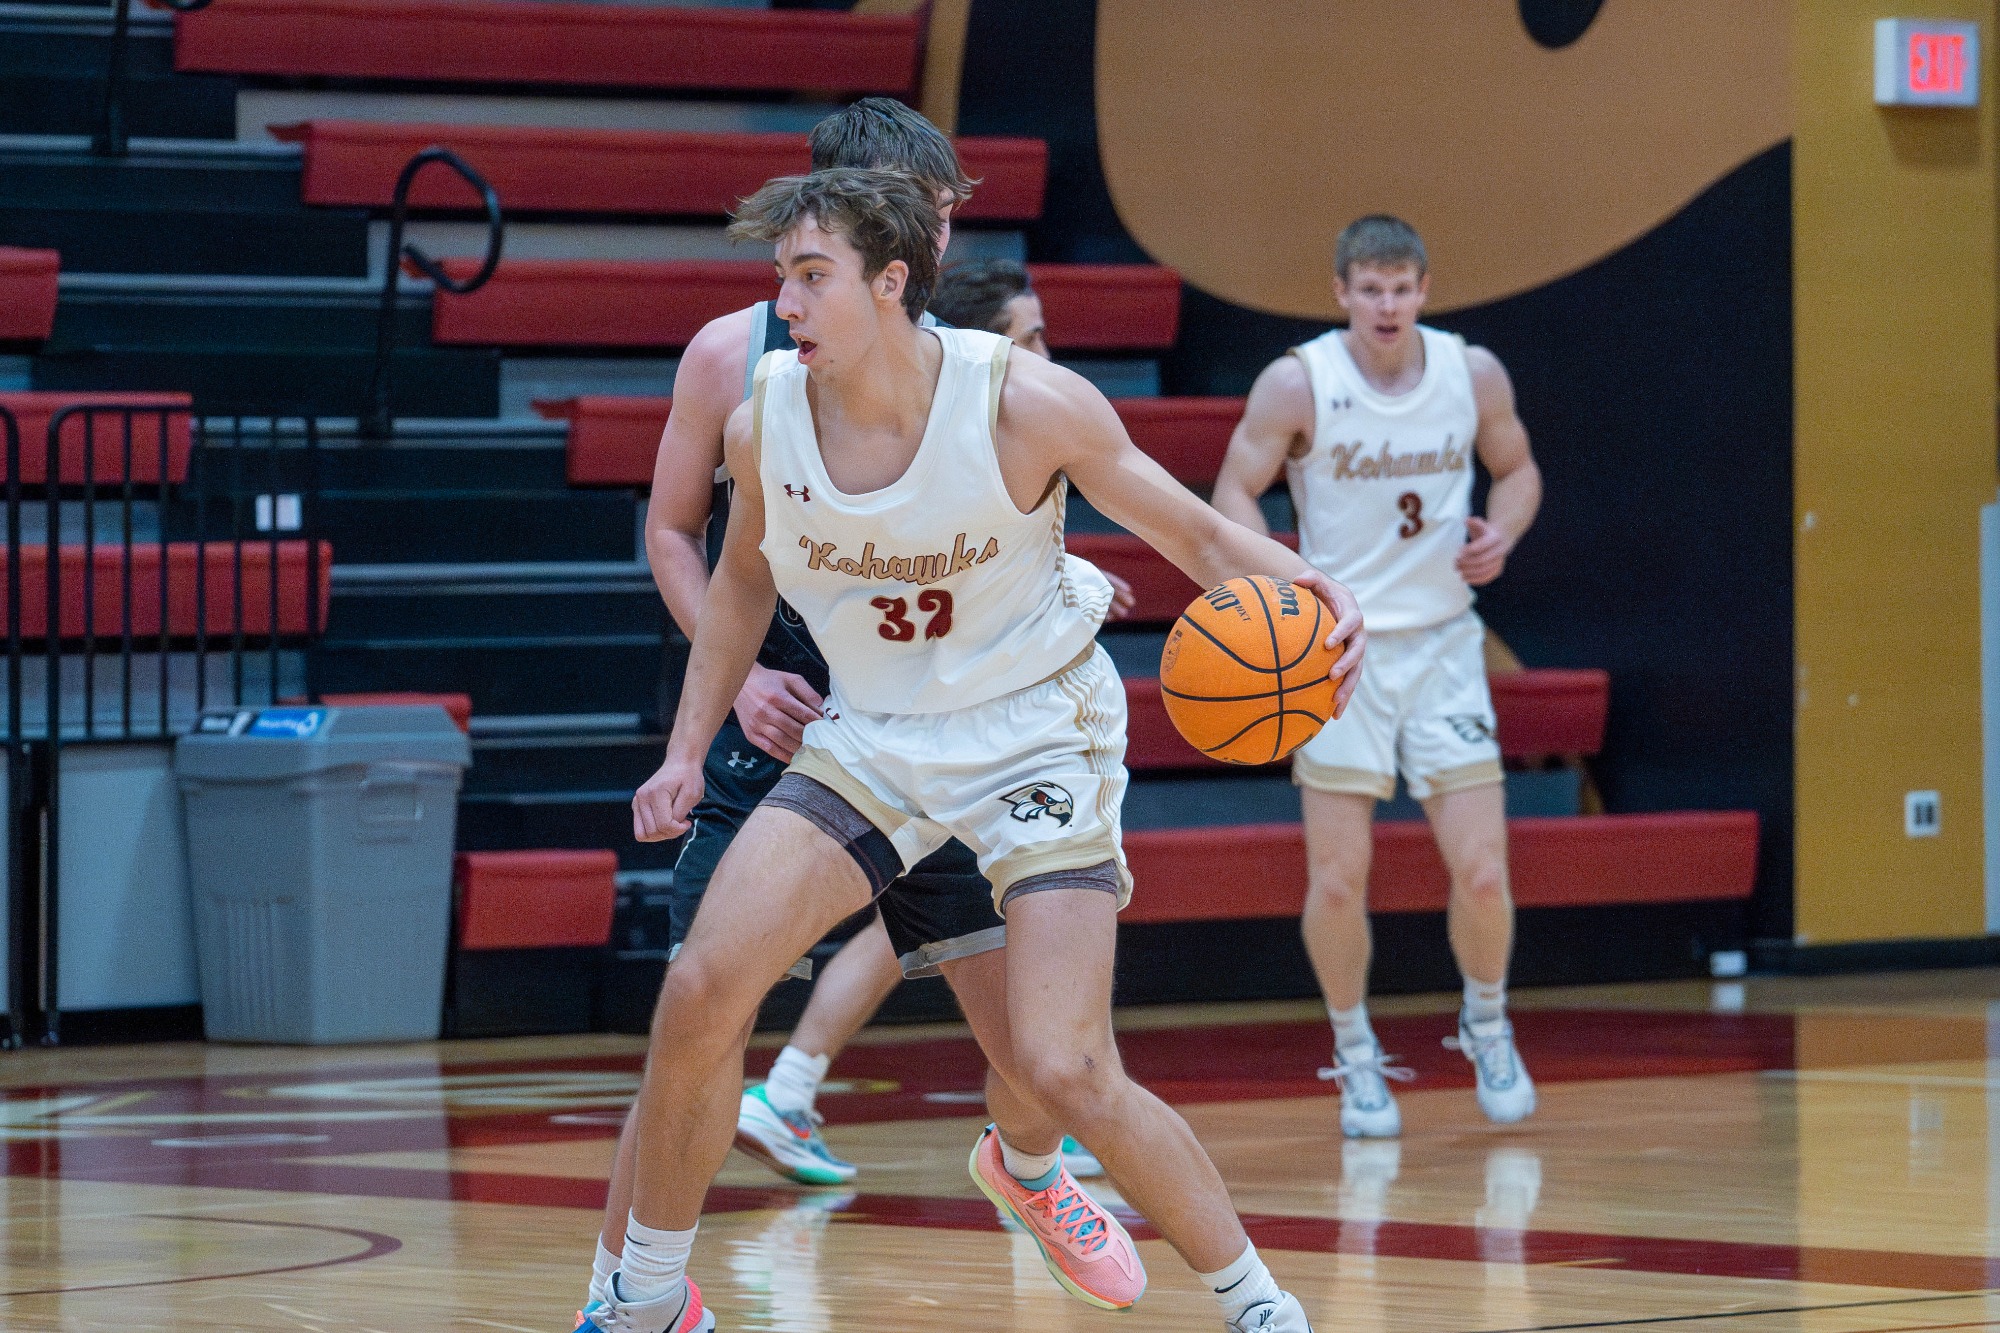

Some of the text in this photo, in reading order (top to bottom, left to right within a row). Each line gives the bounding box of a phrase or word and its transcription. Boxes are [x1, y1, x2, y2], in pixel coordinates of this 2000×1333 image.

[1908, 31, 1967, 94] EXIT
[1397, 491, 1425, 539] 3
[798, 532, 1000, 586] Kohawks
